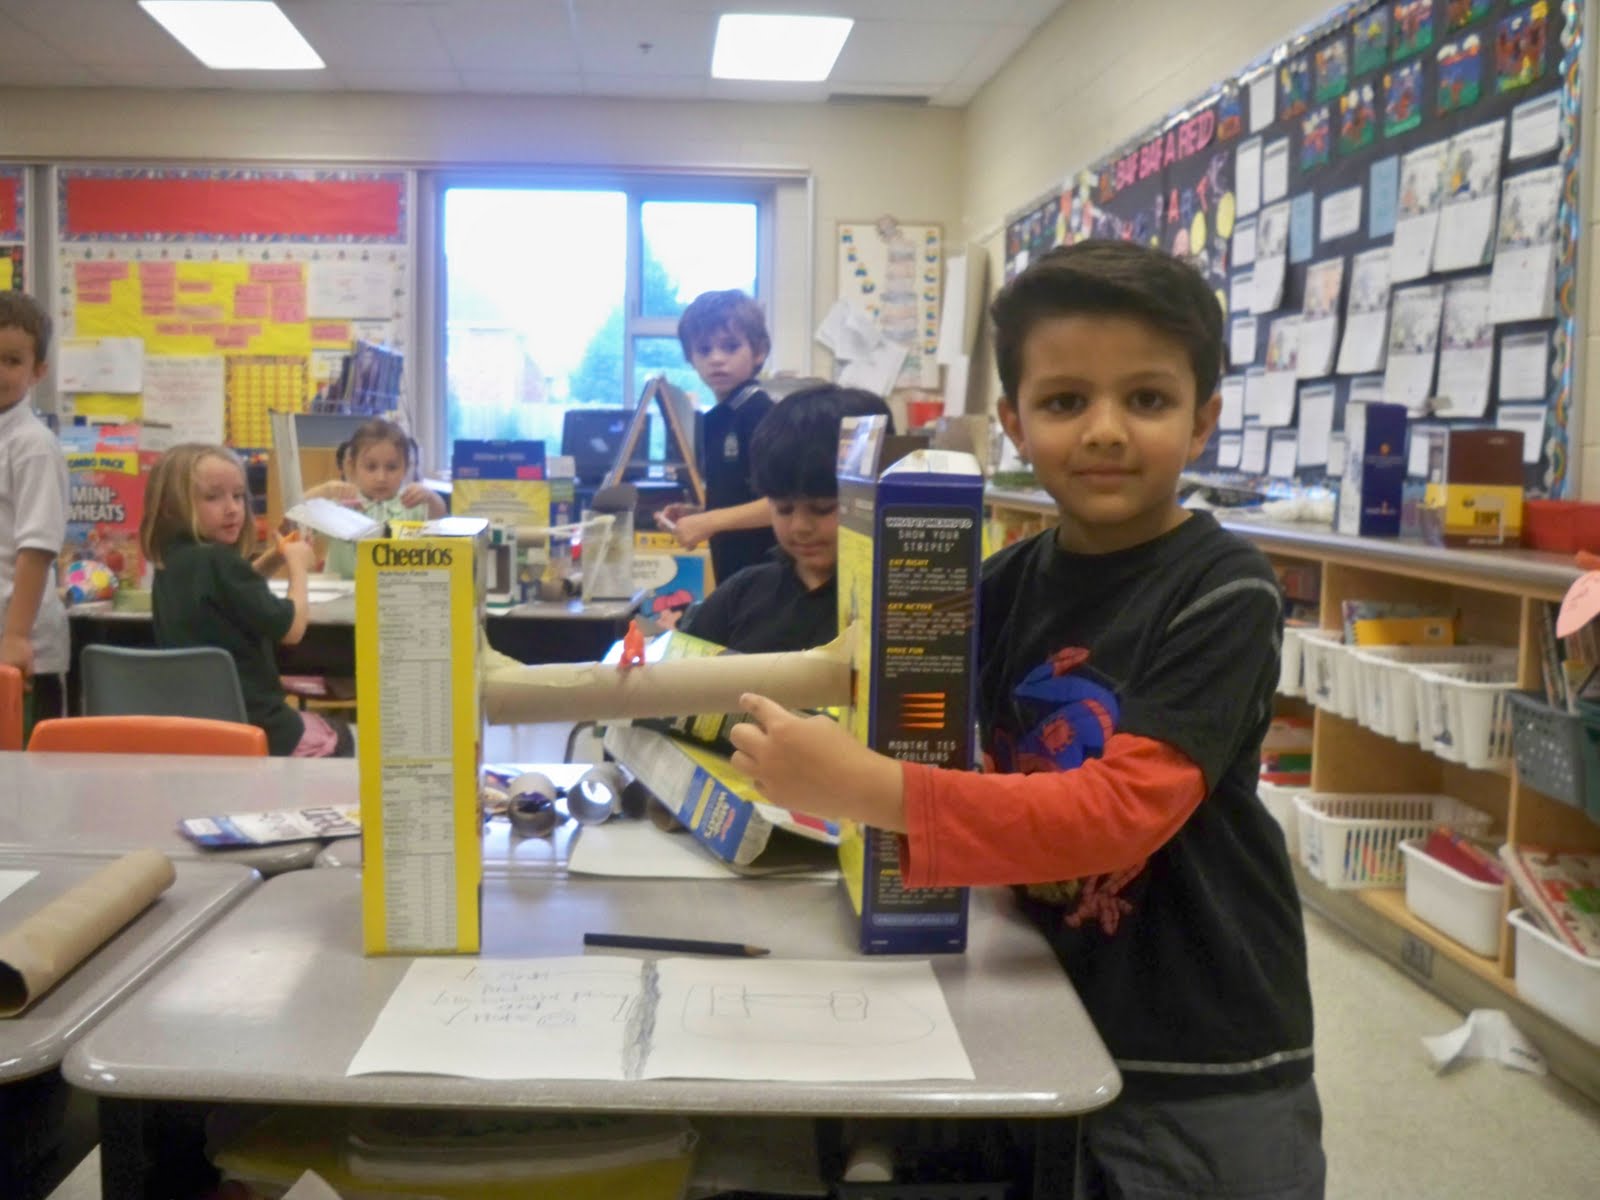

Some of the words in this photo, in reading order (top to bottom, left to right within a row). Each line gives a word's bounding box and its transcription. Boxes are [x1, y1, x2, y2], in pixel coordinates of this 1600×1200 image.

[71, 486, 116, 503] MINI-
[898, 530, 926, 540] SHOW
[933, 530, 960, 540] YOUR
[372, 543, 453, 566] Cheerios
[888, 559, 904, 567] EAT
[905, 559, 930, 567] RIGHT
[886, 647, 907, 655] HAVE
[908, 647, 925, 655] FUN
[888, 741, 929, 750] MONTRE
[937, 741, 957, 751] TES
